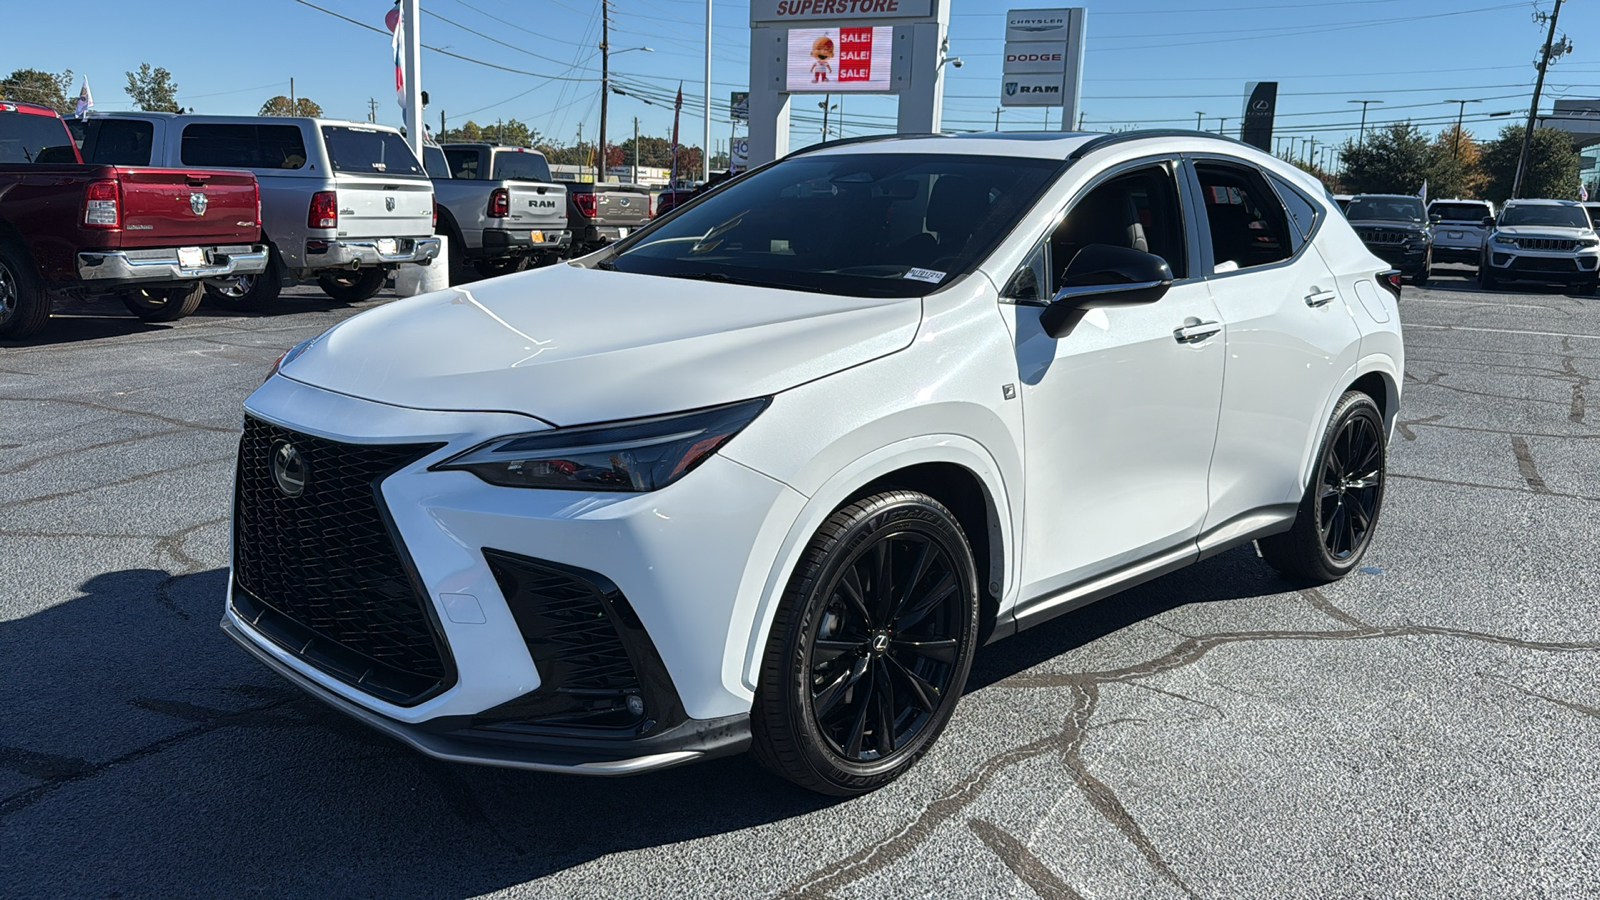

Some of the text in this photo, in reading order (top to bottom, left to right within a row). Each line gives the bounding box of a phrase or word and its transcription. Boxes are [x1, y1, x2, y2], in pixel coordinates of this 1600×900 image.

[776, 0, 899, 16] SUPERSTORE
[840, 33, 871, 43] SALE!
[840, 51, 870, 60] SALE!
[1006, 53, 1062, 62] DODGE
[839, 69, 869, 78] SALE!
[528, 200, 555, 208] RAM
